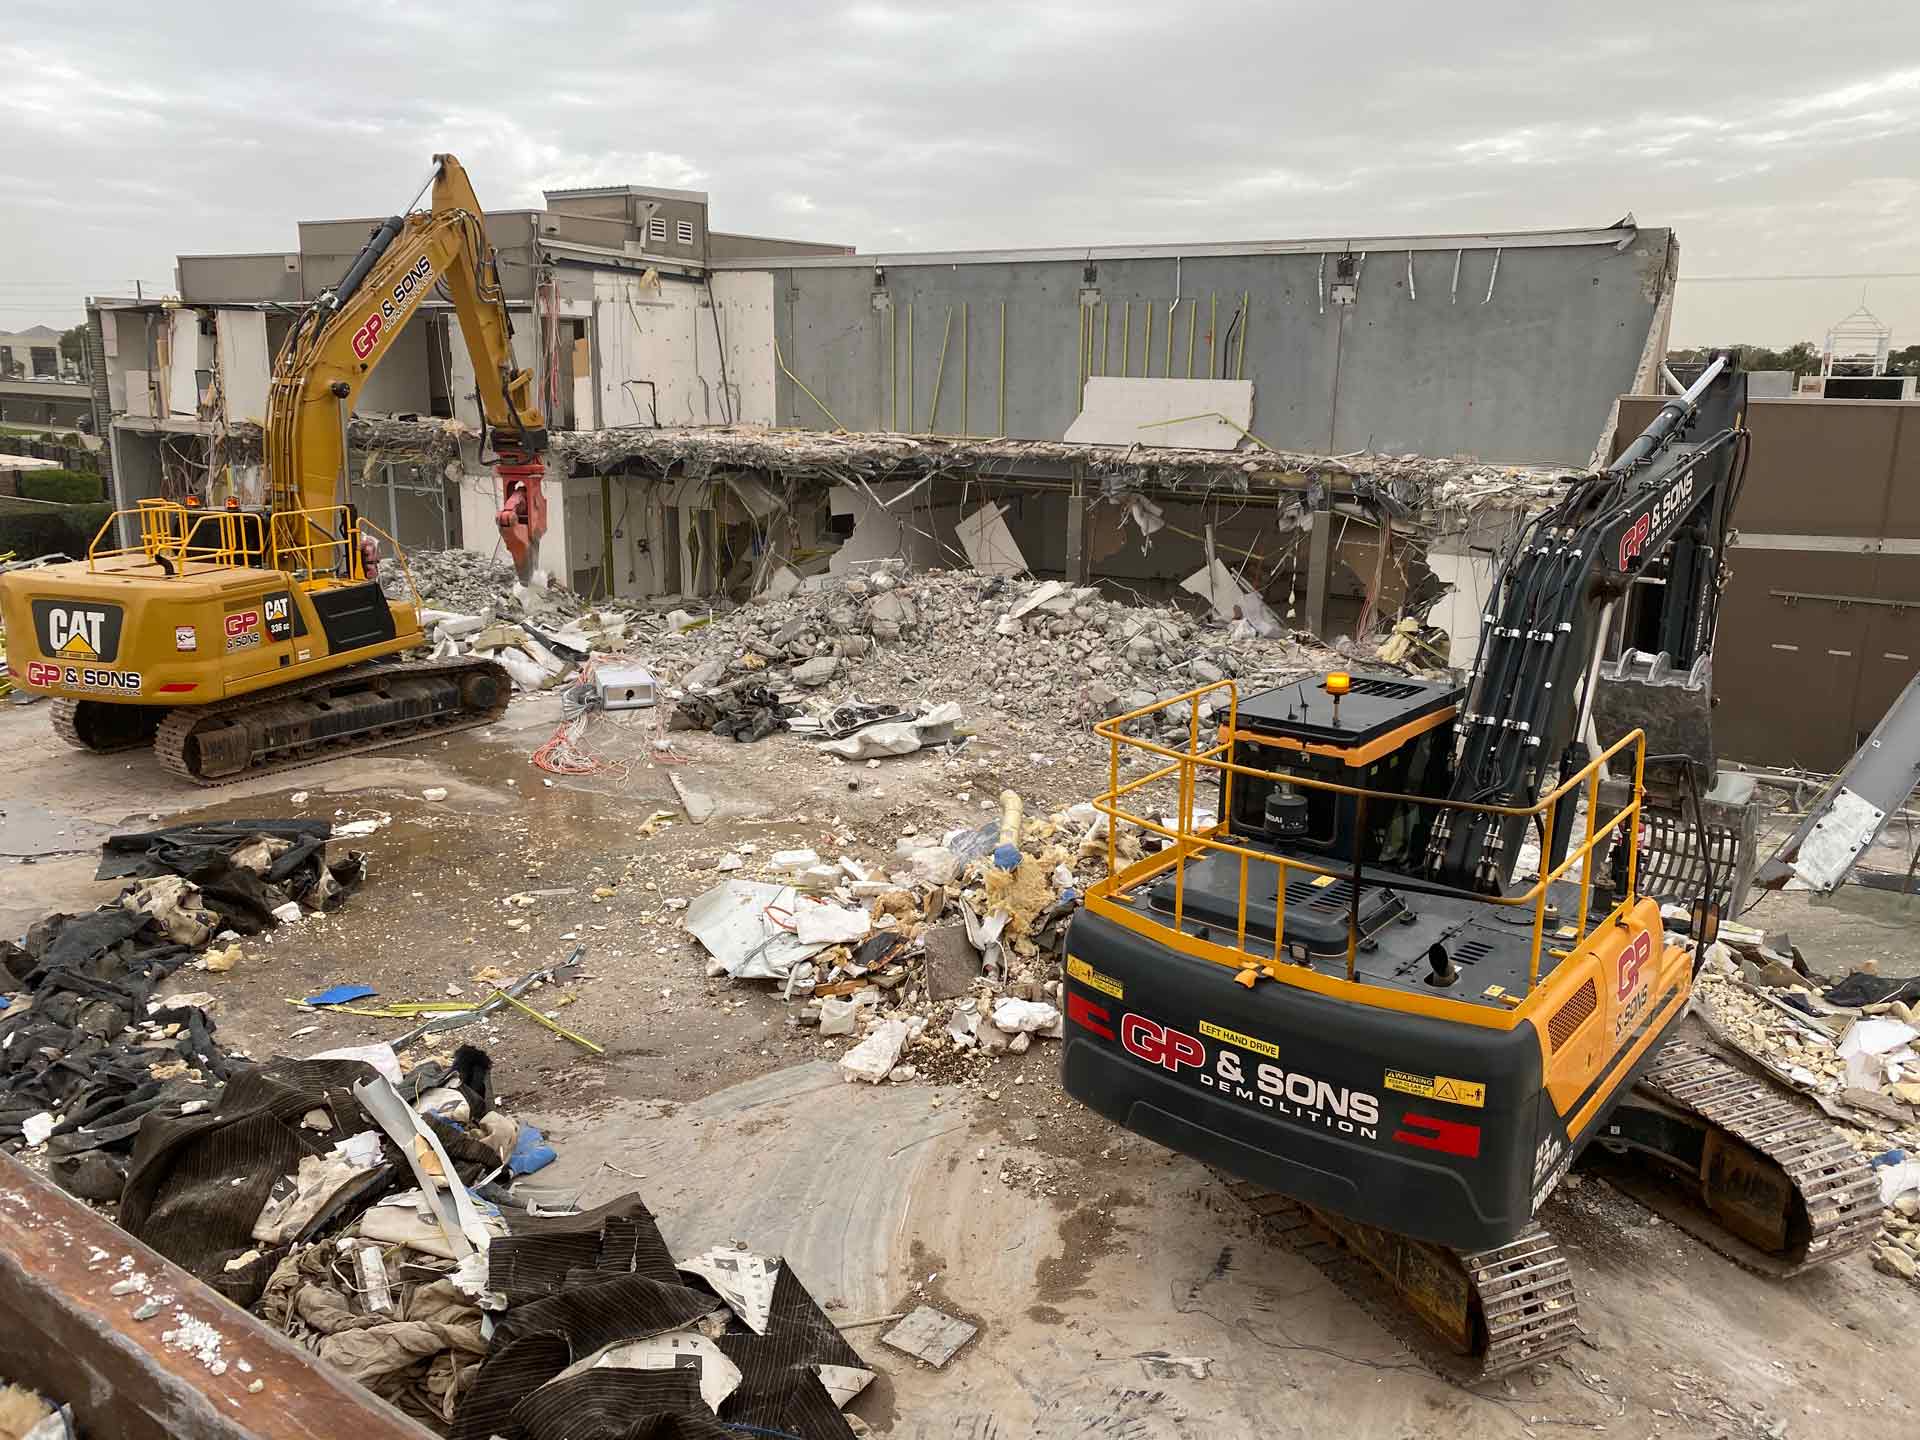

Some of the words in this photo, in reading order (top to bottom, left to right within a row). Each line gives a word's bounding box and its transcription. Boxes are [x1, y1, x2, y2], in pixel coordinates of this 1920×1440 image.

[352, 313, 383, 360] GP
[381, 298, 395, 319] &
[393, 255, 431, 303] SONS
[1645, 495, 1692, 547] DEMOLITION
[1651, 502, 1660, 529] &
[1662, 469, 1694, 518] SONS
[49, 608, 105, 654] CAT
[224, 610, 259, 638] GP
[264, 598, 288, 621] CAT
[235, 632, 259, 647] SONS
[27, 661, 62, 688] GP
[64, 666, 79, 684] &
[83, 668, 142, 690] SONS
[1616, 929, 1651, 1003] GP
[1624, 983, 1649, 1027] SONS
[1201, 1023, 1221, 1037] LEFT
[1223, 1031, 1248, 1046] HAND
[1249, 1040, 1277, 1056] DRIVE
[1121, 1012, 1206, 1072] GP
[1217, 1050, 1245, 1083] &
[1257, 1063, 1379, 1125] SONS
[1395, 1072, 1433, 1086] WARNING
[1200, 1073, 1377, 1140] DEMOLITION
